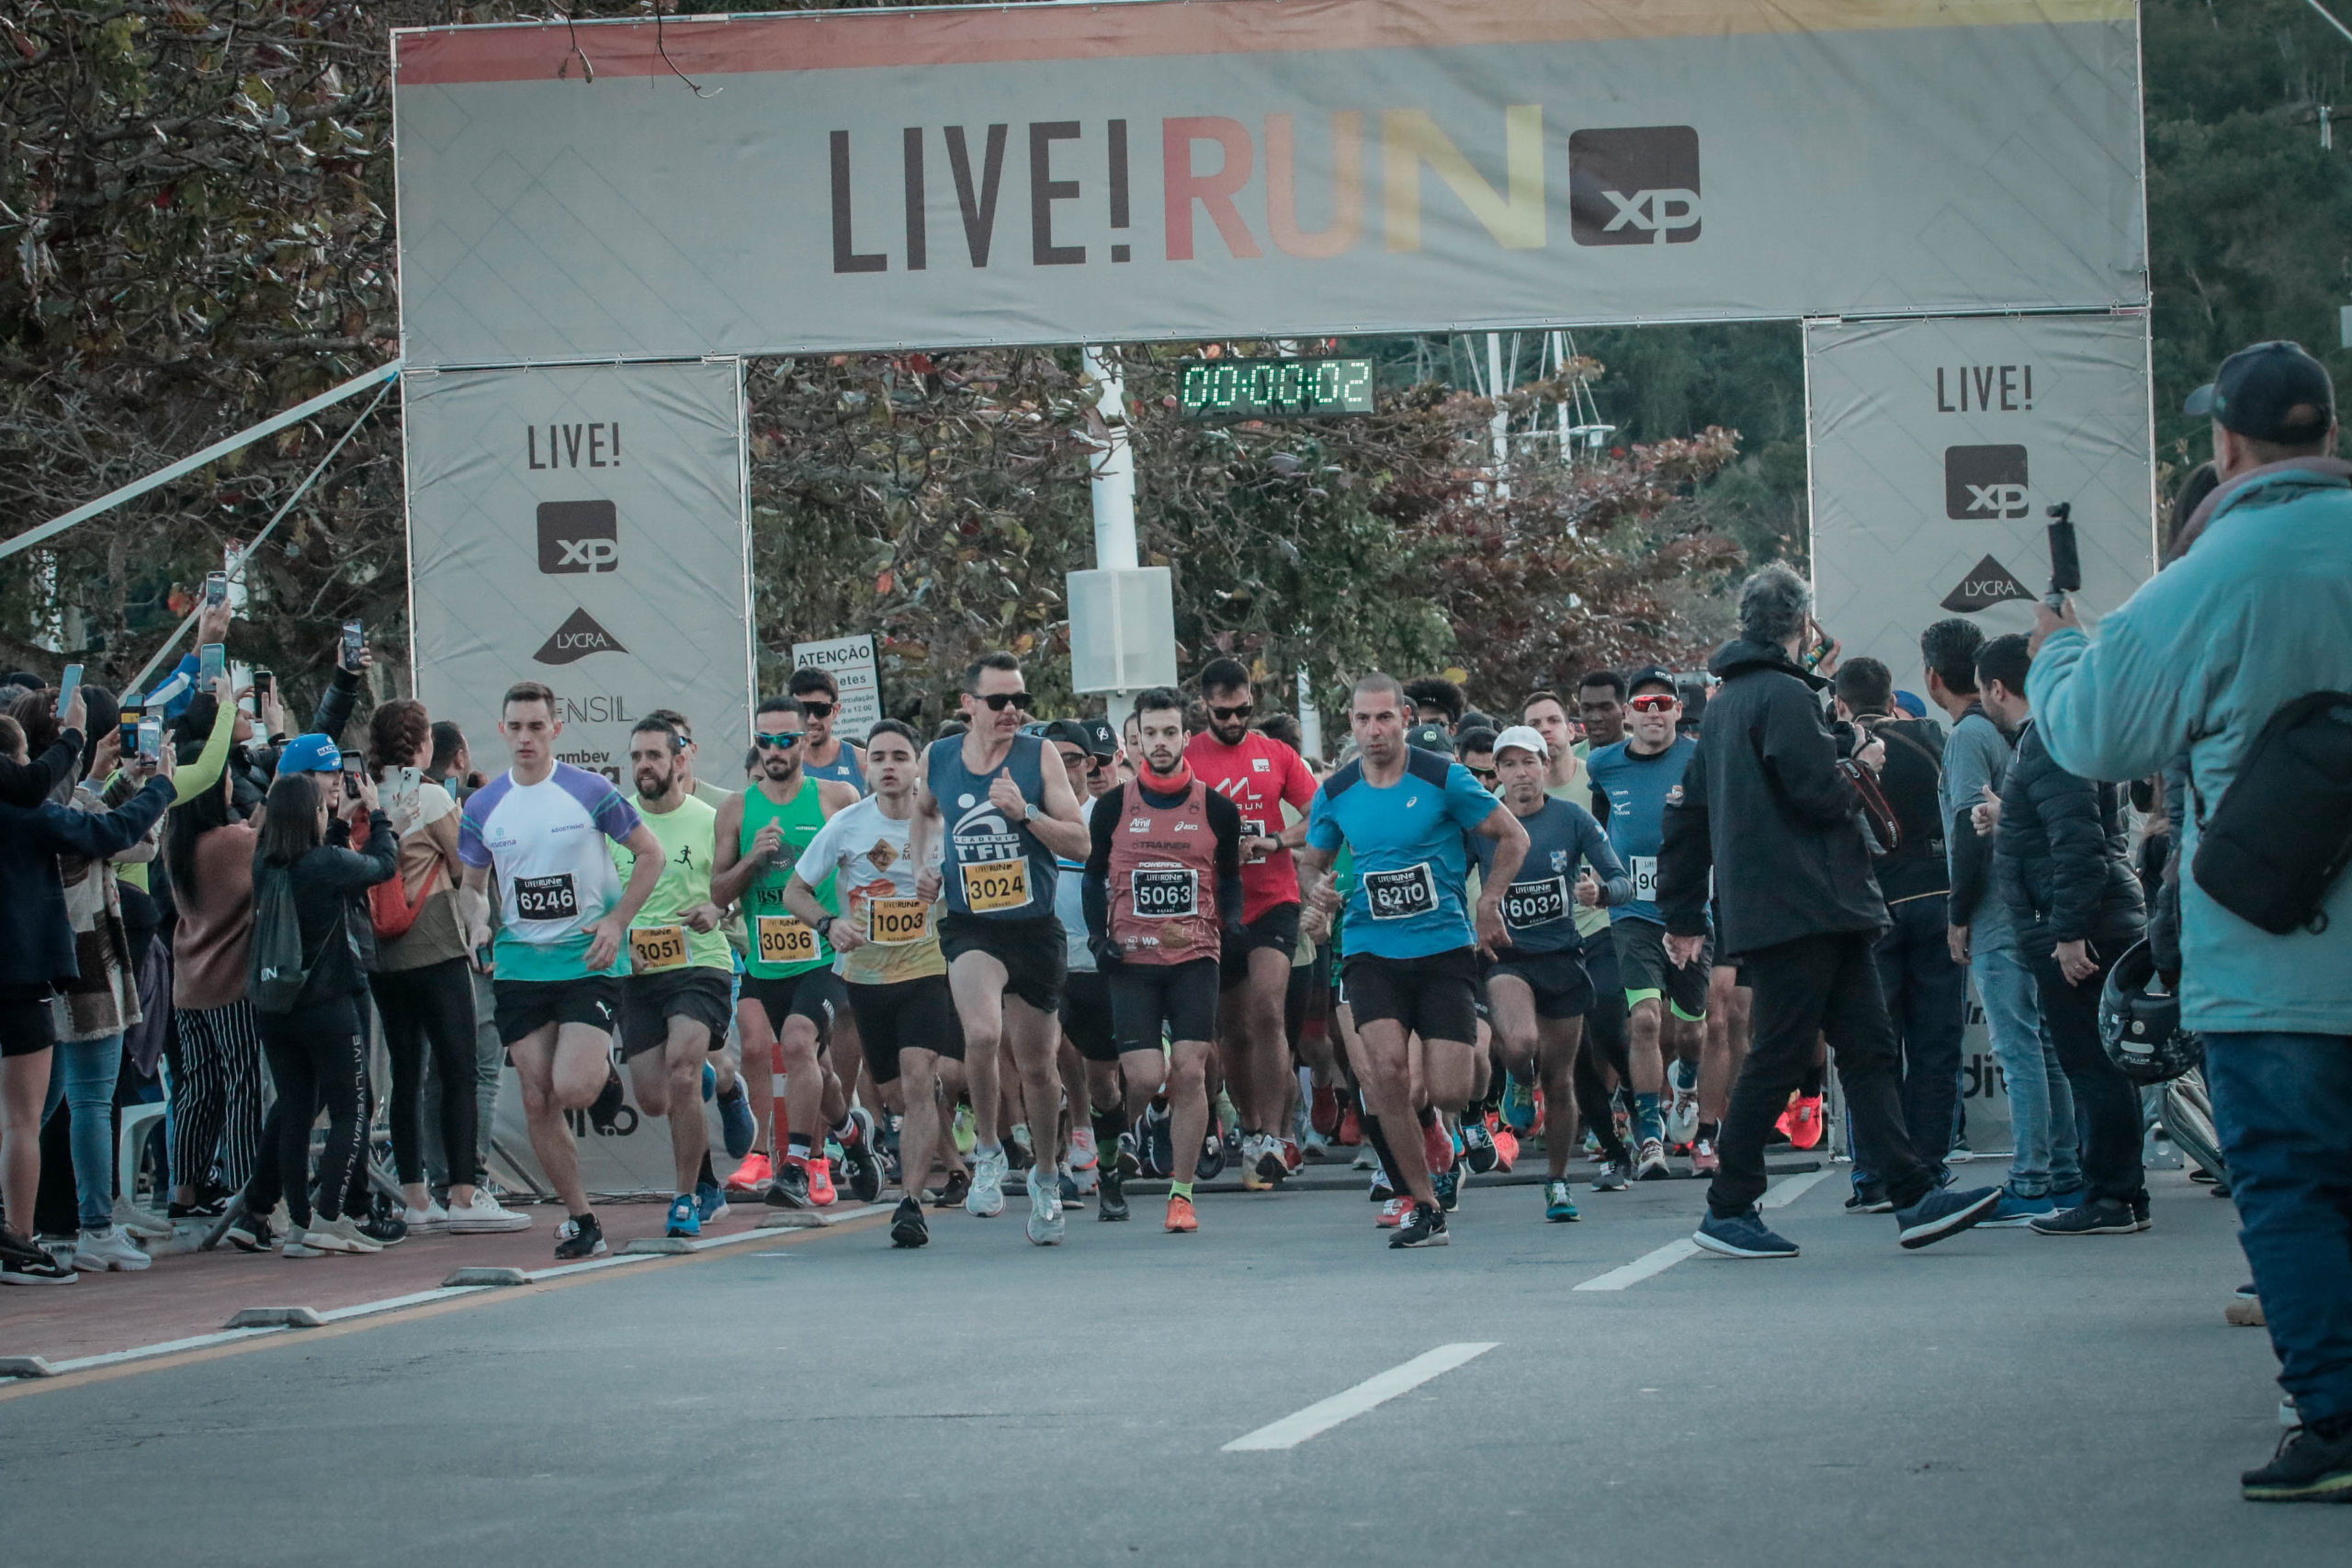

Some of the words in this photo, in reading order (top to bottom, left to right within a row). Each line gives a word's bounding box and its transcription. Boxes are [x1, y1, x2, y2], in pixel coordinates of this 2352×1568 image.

[1184, 362, 1369, 406] 00:00:02
[1937, 365, 2032, 412] LIVE!
[528, 423, 620, 469] LIVE!
[1965, 580, 2017, 596] LYCRA
[557, 632, 607, 649] LYCRA
[798, 645, 870, 667] ATENÇÃO
[555, 695, 633, 724] ENSIL
[556, 749, 610, 764] ambev
[956, 833, 1018, 843] ACADEMIA
[970, 875, 1023, 899] 3024
[1140, 885, 1191, 905] 5063
[1378, 882, 1425, 907] 6210
[520, 889, 573, 910] 6246
[1510, 894, 1561, 918] 6032
[877, 912, 923, 932] 1003
[636, 939, 681, 961] 3051
[763, 931, 811, 952] 3036
